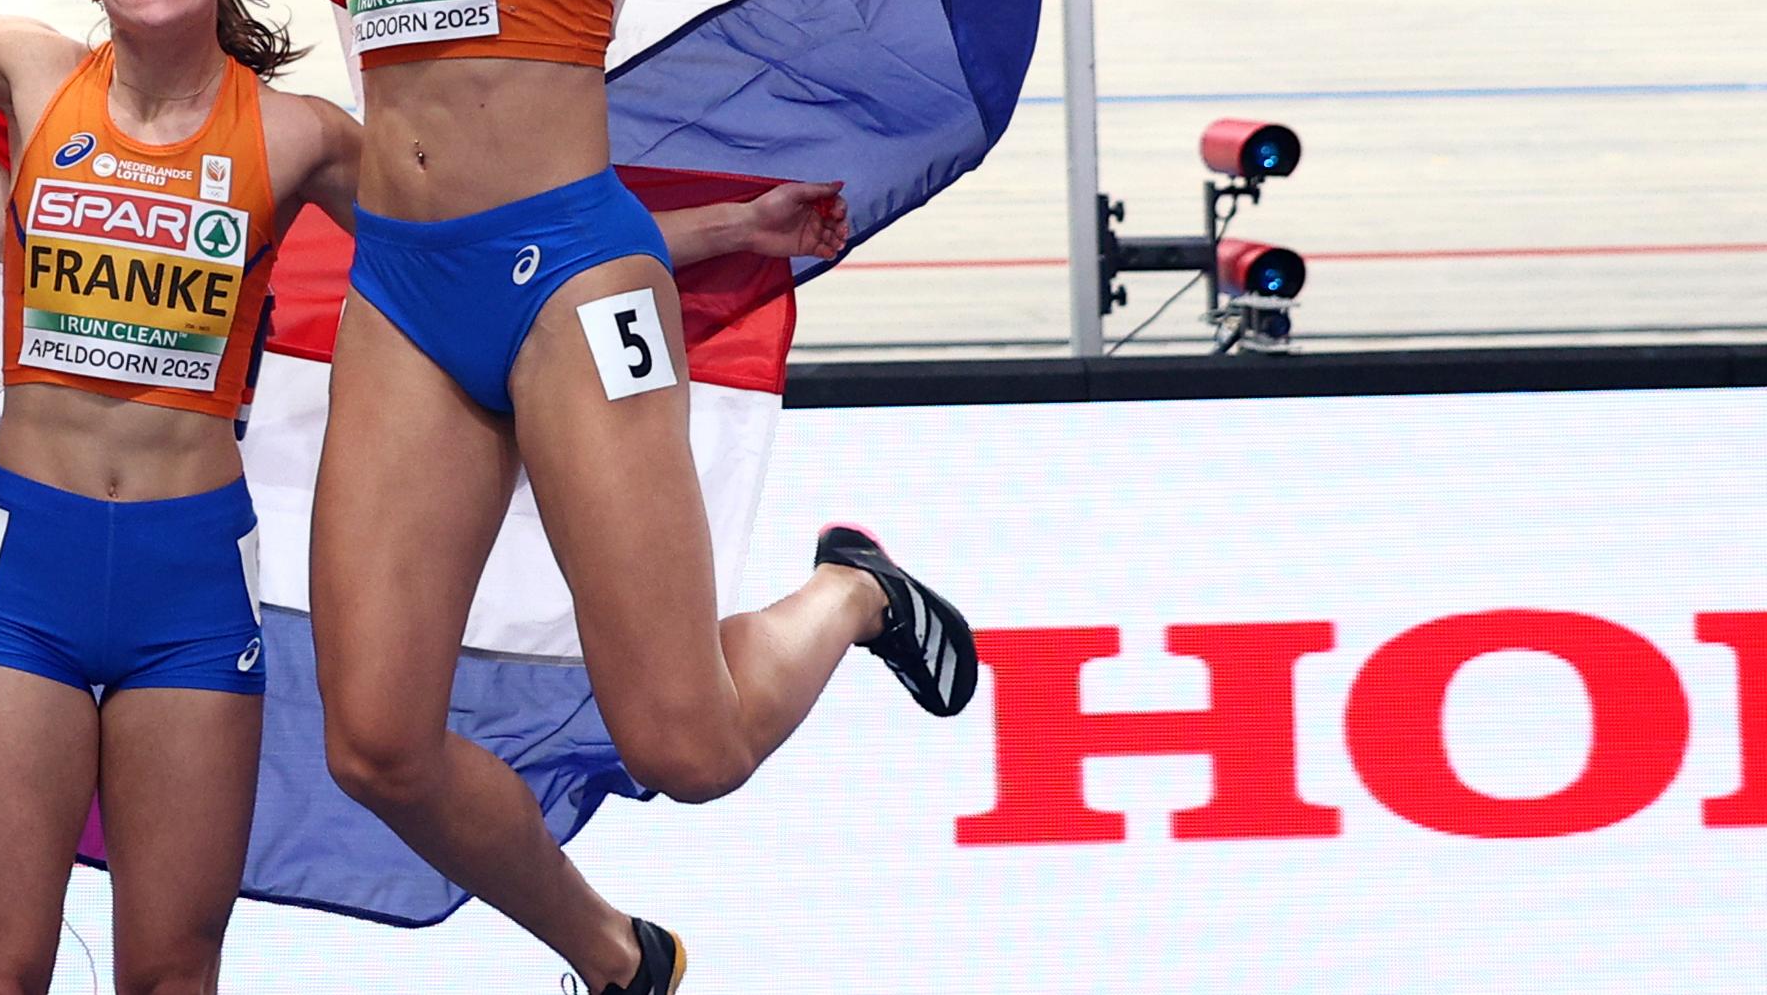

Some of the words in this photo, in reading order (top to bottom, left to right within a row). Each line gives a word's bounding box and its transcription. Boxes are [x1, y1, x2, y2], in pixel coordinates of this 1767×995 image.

[434, 6, 491, 30] 2025
[116, 169, 167, 186] LOTERIJ
[118, 160, 193, 180] NEDERLANDSE
[36, 192, 187, 243] SPAR
[29, 245, 235, 317] FRANKE
[67, 316, 110, 337] RUN
[614, 309, 652, 378] 5
[28, 339, 158, 375] APELDOORN
[161, 358, 213, 381] 2025
[955, 608, 1767, 845] HO
